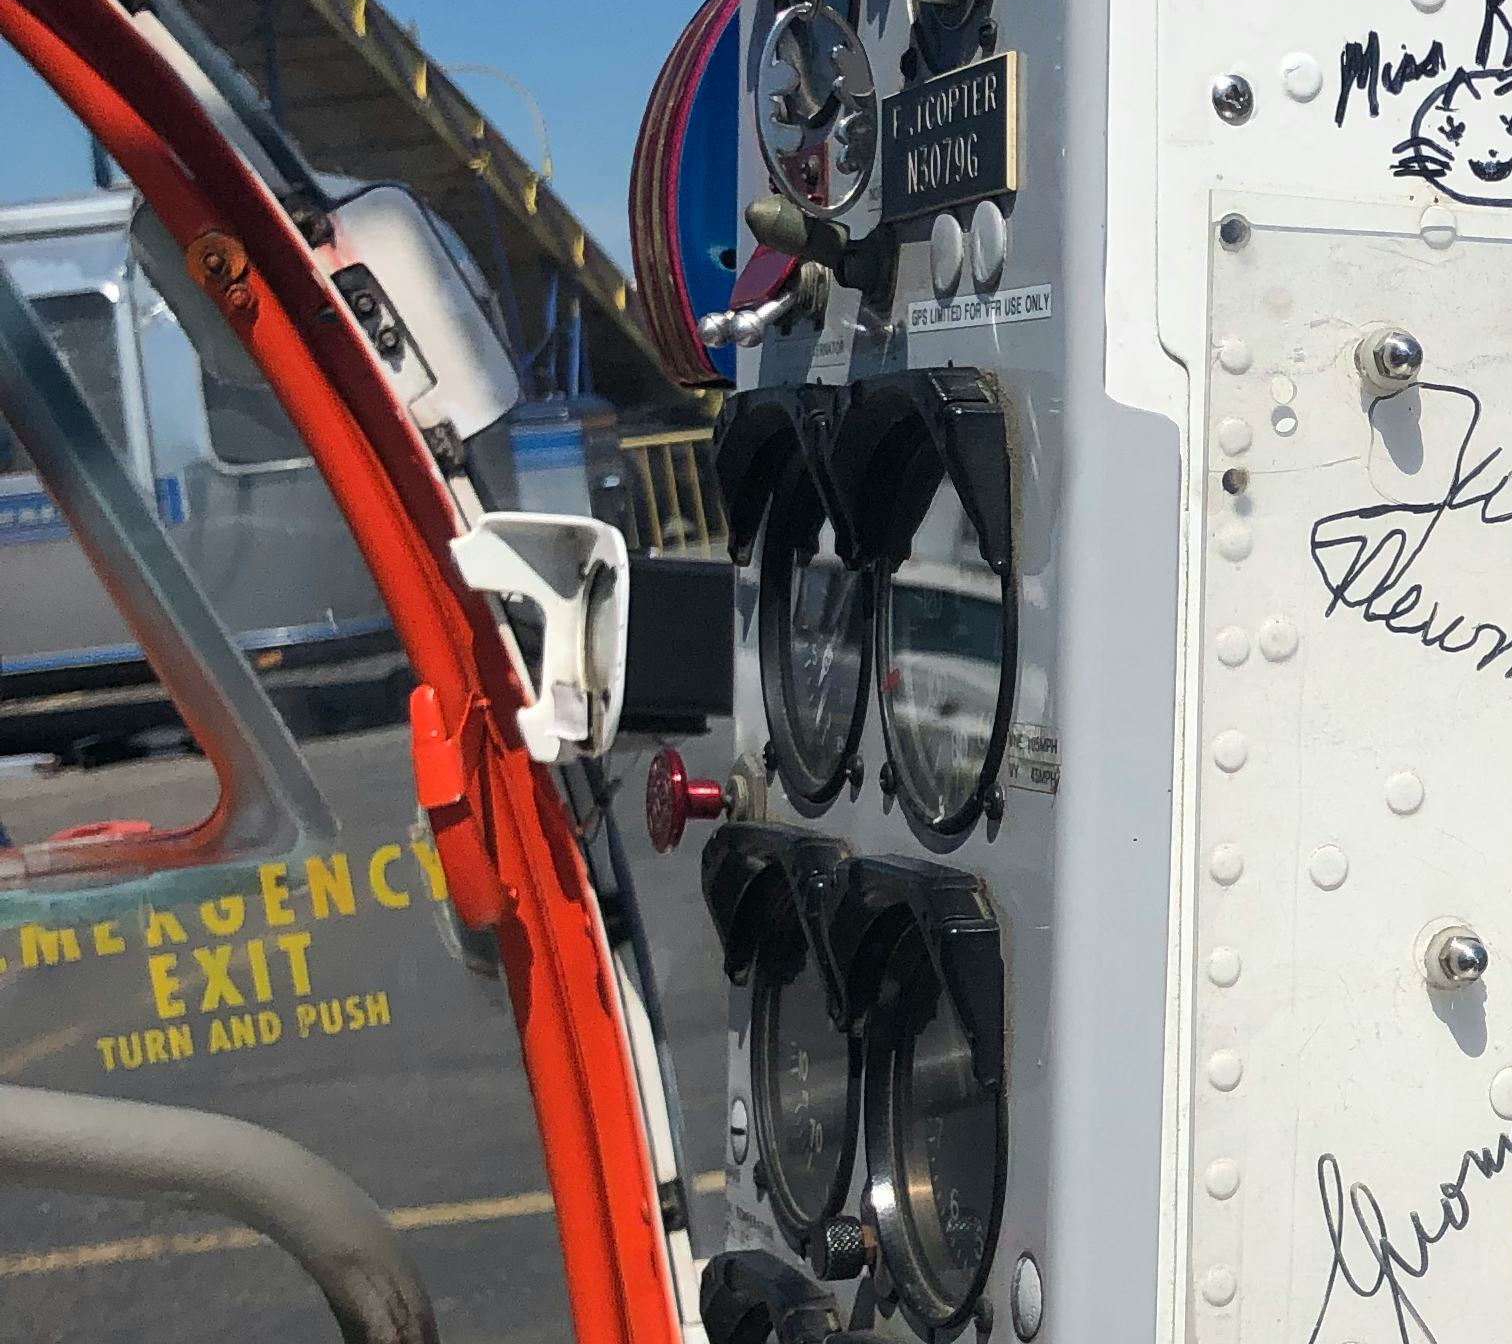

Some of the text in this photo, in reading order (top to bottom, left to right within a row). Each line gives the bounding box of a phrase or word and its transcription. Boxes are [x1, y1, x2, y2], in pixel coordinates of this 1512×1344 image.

[911, 307, 928, 328] GPS
[930, 302, 961, 324] LIMITED
[964, 301, 981, 321] FOR
[1004, 296, 1023, 317] USE
[1025, 293, 1050, 315] ONLY
[0, 841, 448, 974] MERGENCY
[148, 932, 312, 1020] EXIT
[96, 991, 391, 1072] TURN AND PUSH
